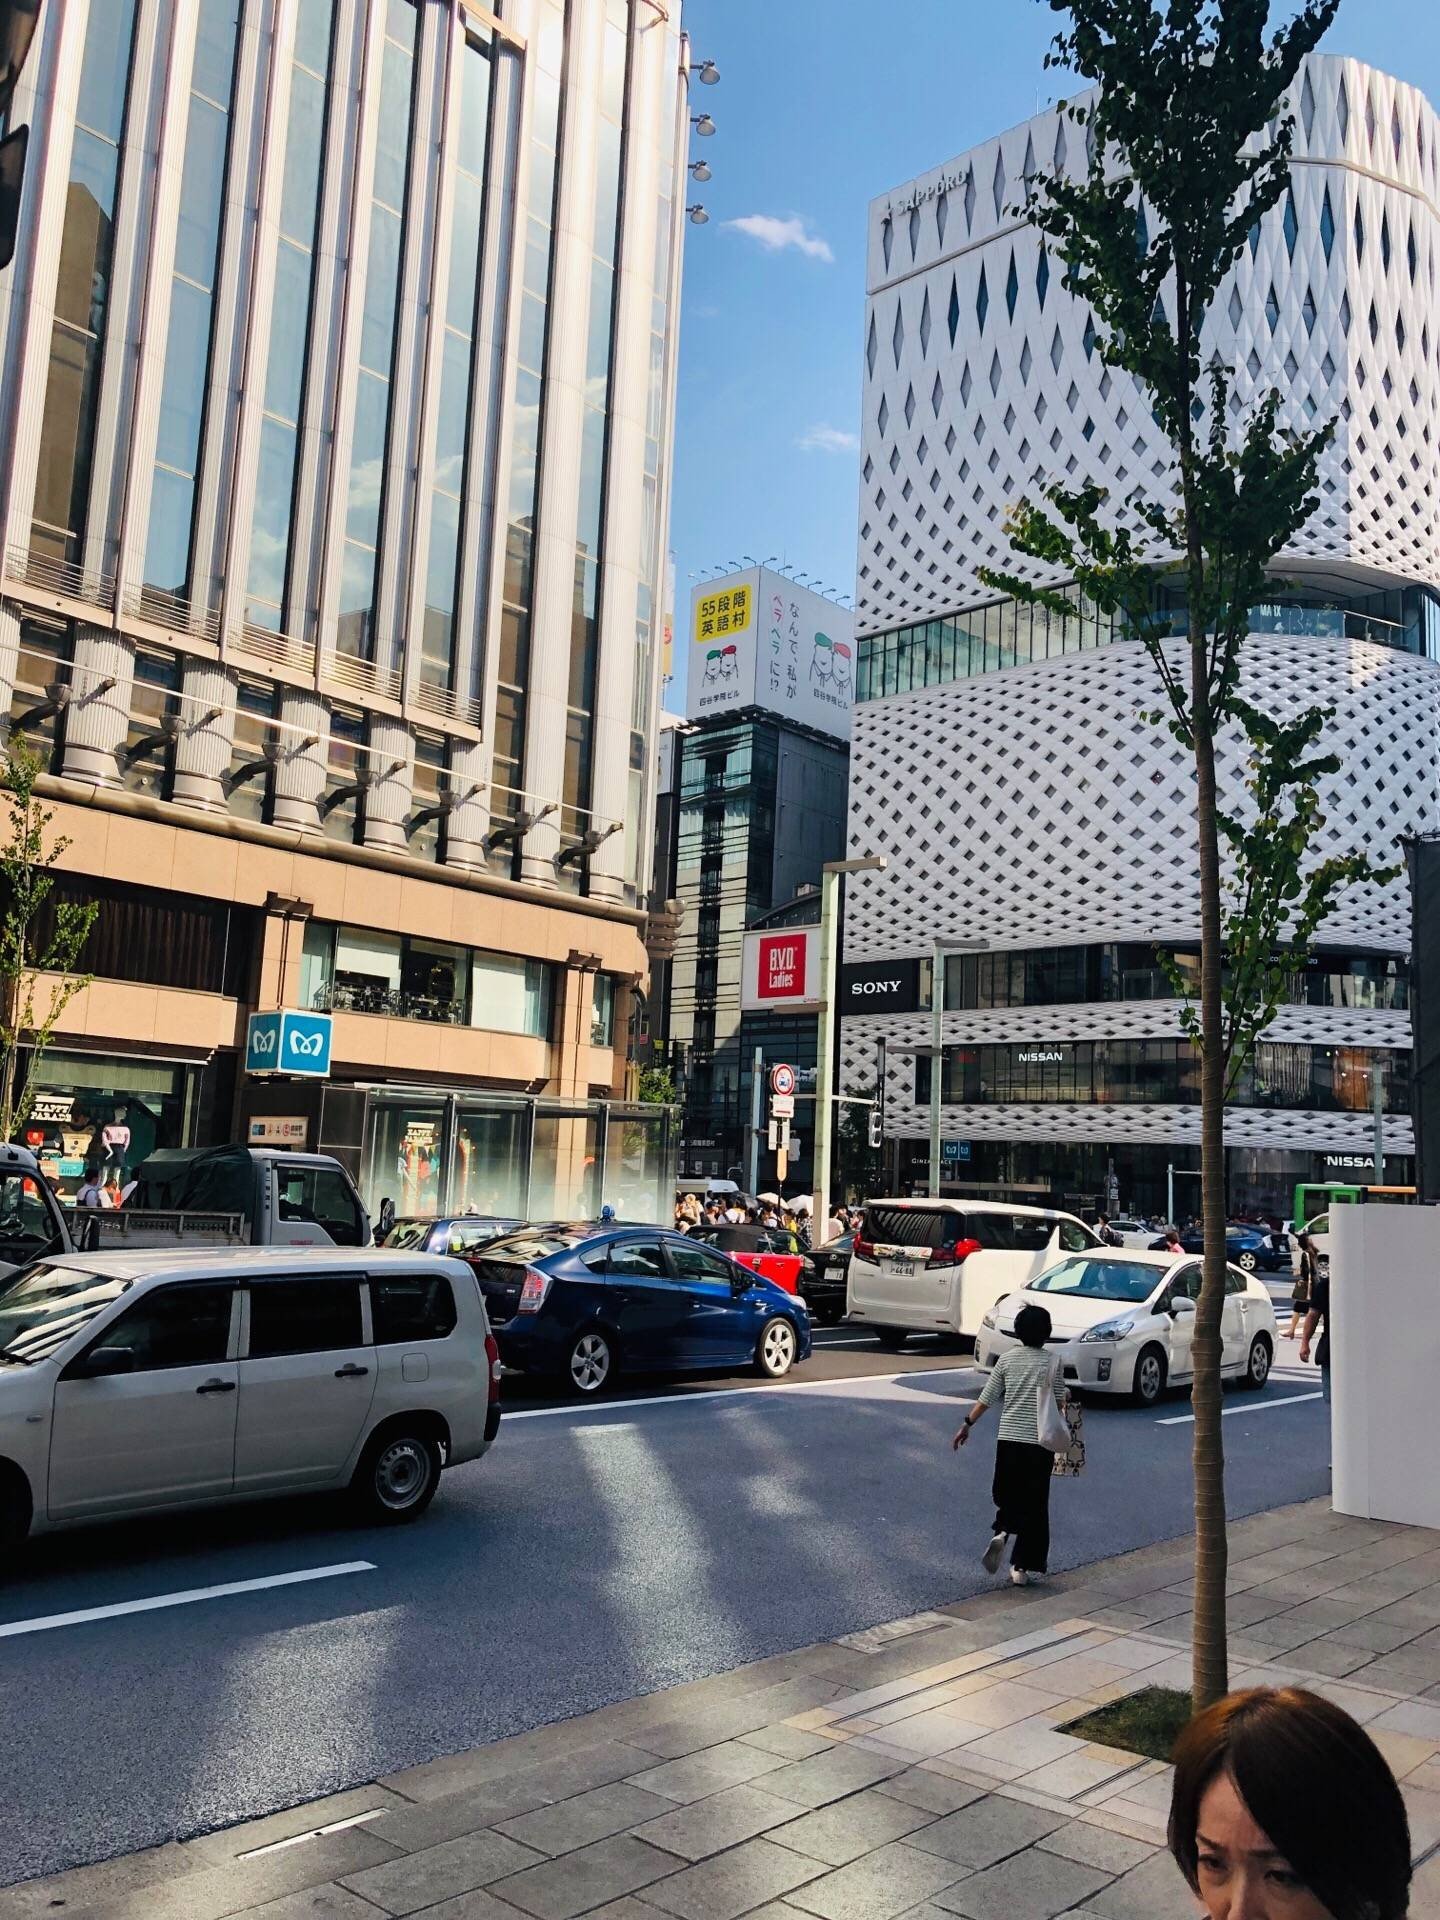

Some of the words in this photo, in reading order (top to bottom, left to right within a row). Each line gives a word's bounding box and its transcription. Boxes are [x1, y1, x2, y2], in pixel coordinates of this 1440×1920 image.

[701, 590, 746, 618] 55段階
[701, 610, 745, 636] 英語村
[786, 603, 801, 700] なんて、私が
[769, 947, 797, 971] B.V.D.
[769, 972, 794, 989] Ladies
[851, 980, 902, 995] SONY
[1018, 1051, 1064, 1063] NISSAN
[34, 1103, 70, 1114] HAPPY
